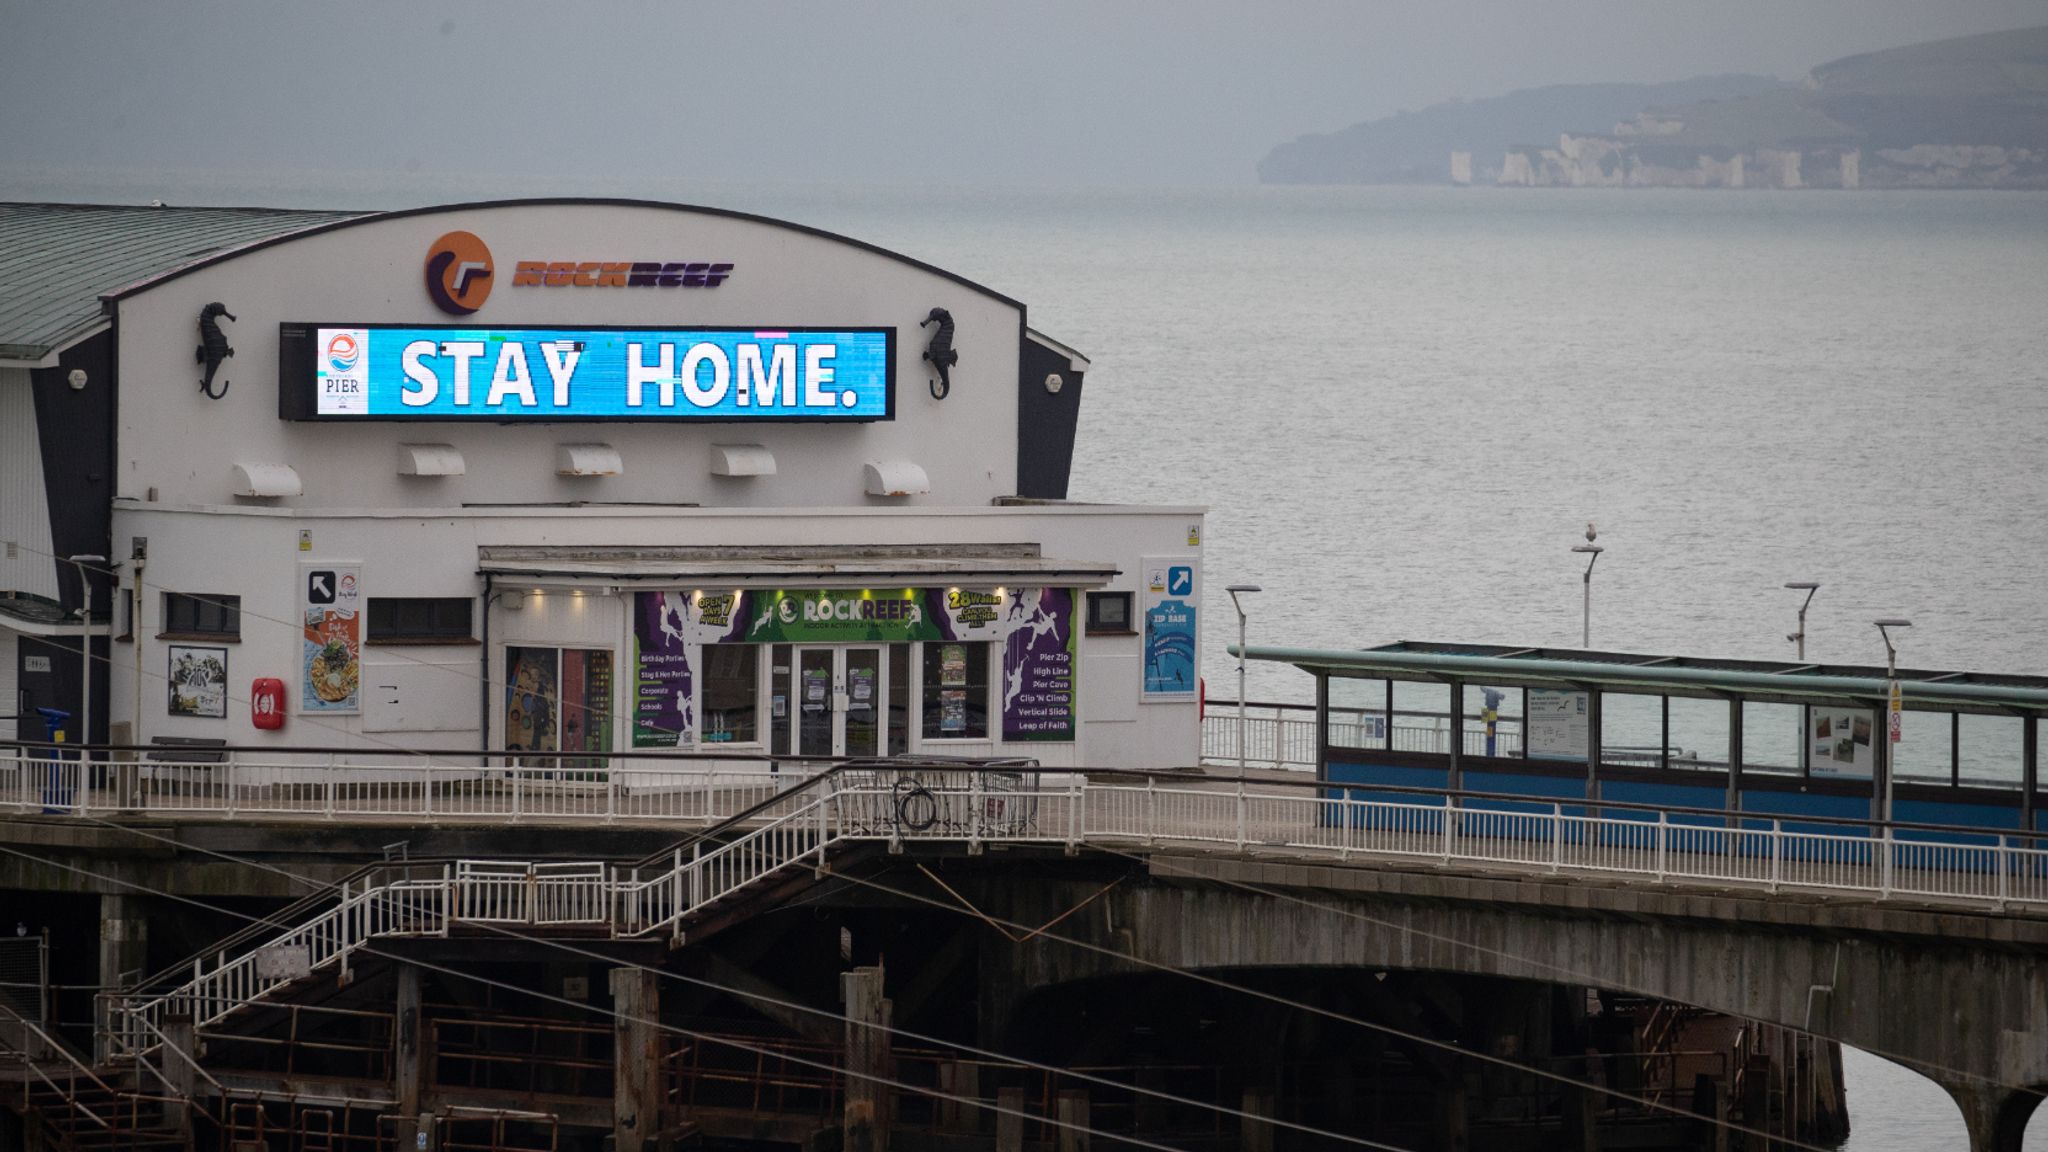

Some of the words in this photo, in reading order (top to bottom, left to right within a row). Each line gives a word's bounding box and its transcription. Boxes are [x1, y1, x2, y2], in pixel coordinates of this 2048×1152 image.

[512, 261, 734, 288] ROCKREEF
[401, 340, 585, 406] STAY
[626, 342, 858, 407] HOME.
[326, 379, 359, 393] PIER
[698, 597, 722, 608] OPEN
[722, 594, 735, 616] 7
[948, 591, 971, 610] 28
[804, 599, 911, 622] ROCKREEF
[641, 655, 664, 664] Birthday
[665, 654, 685, 662] Parties
[1040, 653, 1054, 661] Pier
[1056, 653, 1069, 662] Zip
[1033, 667, 1051, 677] High
[1052, 667, 1069, 675] Line
[641, 687, 669, 695] Corporate
[1020, 695, 1035, 703] Clip
[1046, 694, 1068, 702] Climb
[1018, 708, 1048, 716] Vertical
[1048, 708, 1068, 716] Slide
[1019, 722, 1037, 731] Leap
